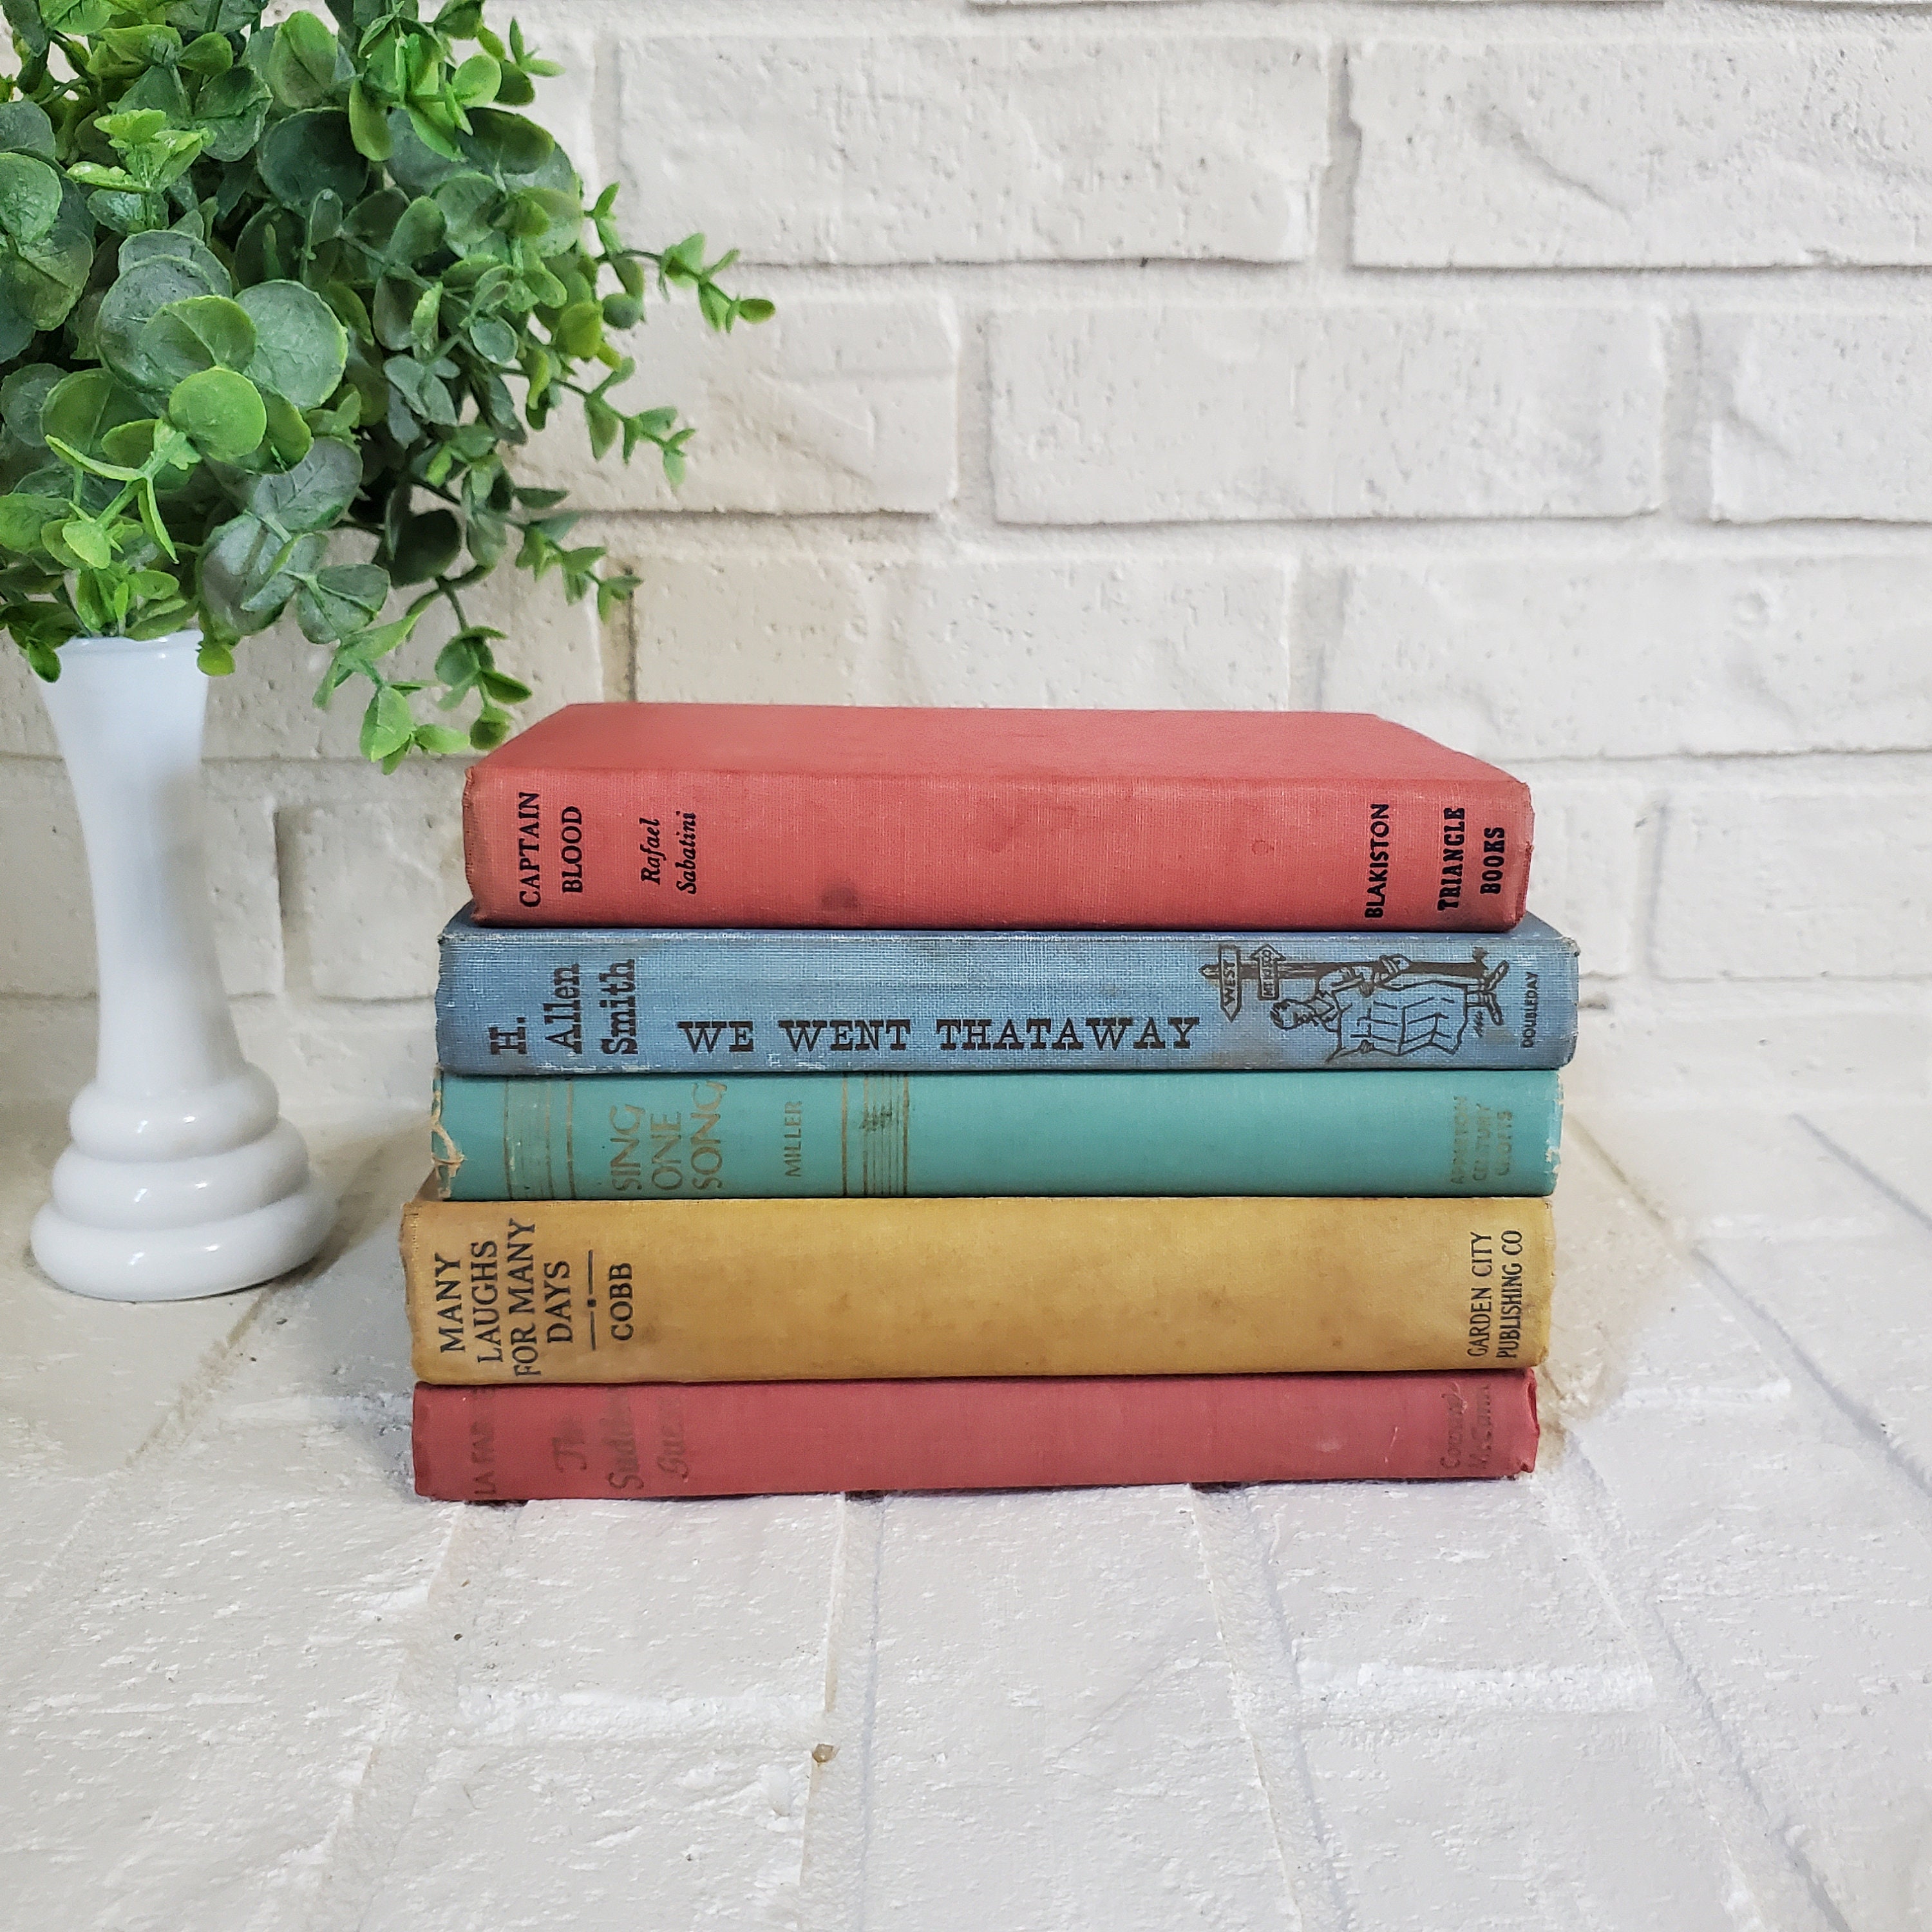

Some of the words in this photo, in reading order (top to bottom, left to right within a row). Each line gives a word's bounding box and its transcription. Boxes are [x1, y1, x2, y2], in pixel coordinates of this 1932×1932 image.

[519, 791, 541, 907] CAPTAIN
[562, 806, 583, 894] BLOOD
[639, 818, 667, 886] Rafael
[676, 811, 697, 895] Sabatini
[1365, 803, 1389, 918] BLAKISTON
[1437, 807, 1465, 911] TRIANGLE
[1481, 826, 1505, 894] BOOKS
[543, 963, 583, 1055] Allen
[598, 959, 638, 1055] Smith
[1224, 959, 1236, 1006] WEST
[1521, 971, 1539, 1048] DOUBLEDAY
[488, 1017, 527, 1055] H.
[678, 1020, 754, 1053] WE
[779, 1019, 911, 1053] WENT
[936, 1016, 1200, 1052] THATAWAY
[611, 1103, 644, 1191] SING
[650, 1112, 684, 1191] ONE
[690, 1081, 728, 1190] SONG
[784, 1101, 802, 1177] MILLER
[507, 1218, 536, 1314] MANY
[1469, 1231, 1493, 1278] CITY
[1501, 1229, 1523, 1254] CO
[435, 1253, 465, 1354] MANY
[471, 1240, 503, 1363] LAUGHS
[544, 1260, 573, 1344] DAYS
[609, 1262, 634, 1341] COBB
[1468, 1287, 1492, 1358] GARDEN
[1495, 1258, 1522, 1358] PUBLISHING
[511, 1322, 541, 1376] FOR
